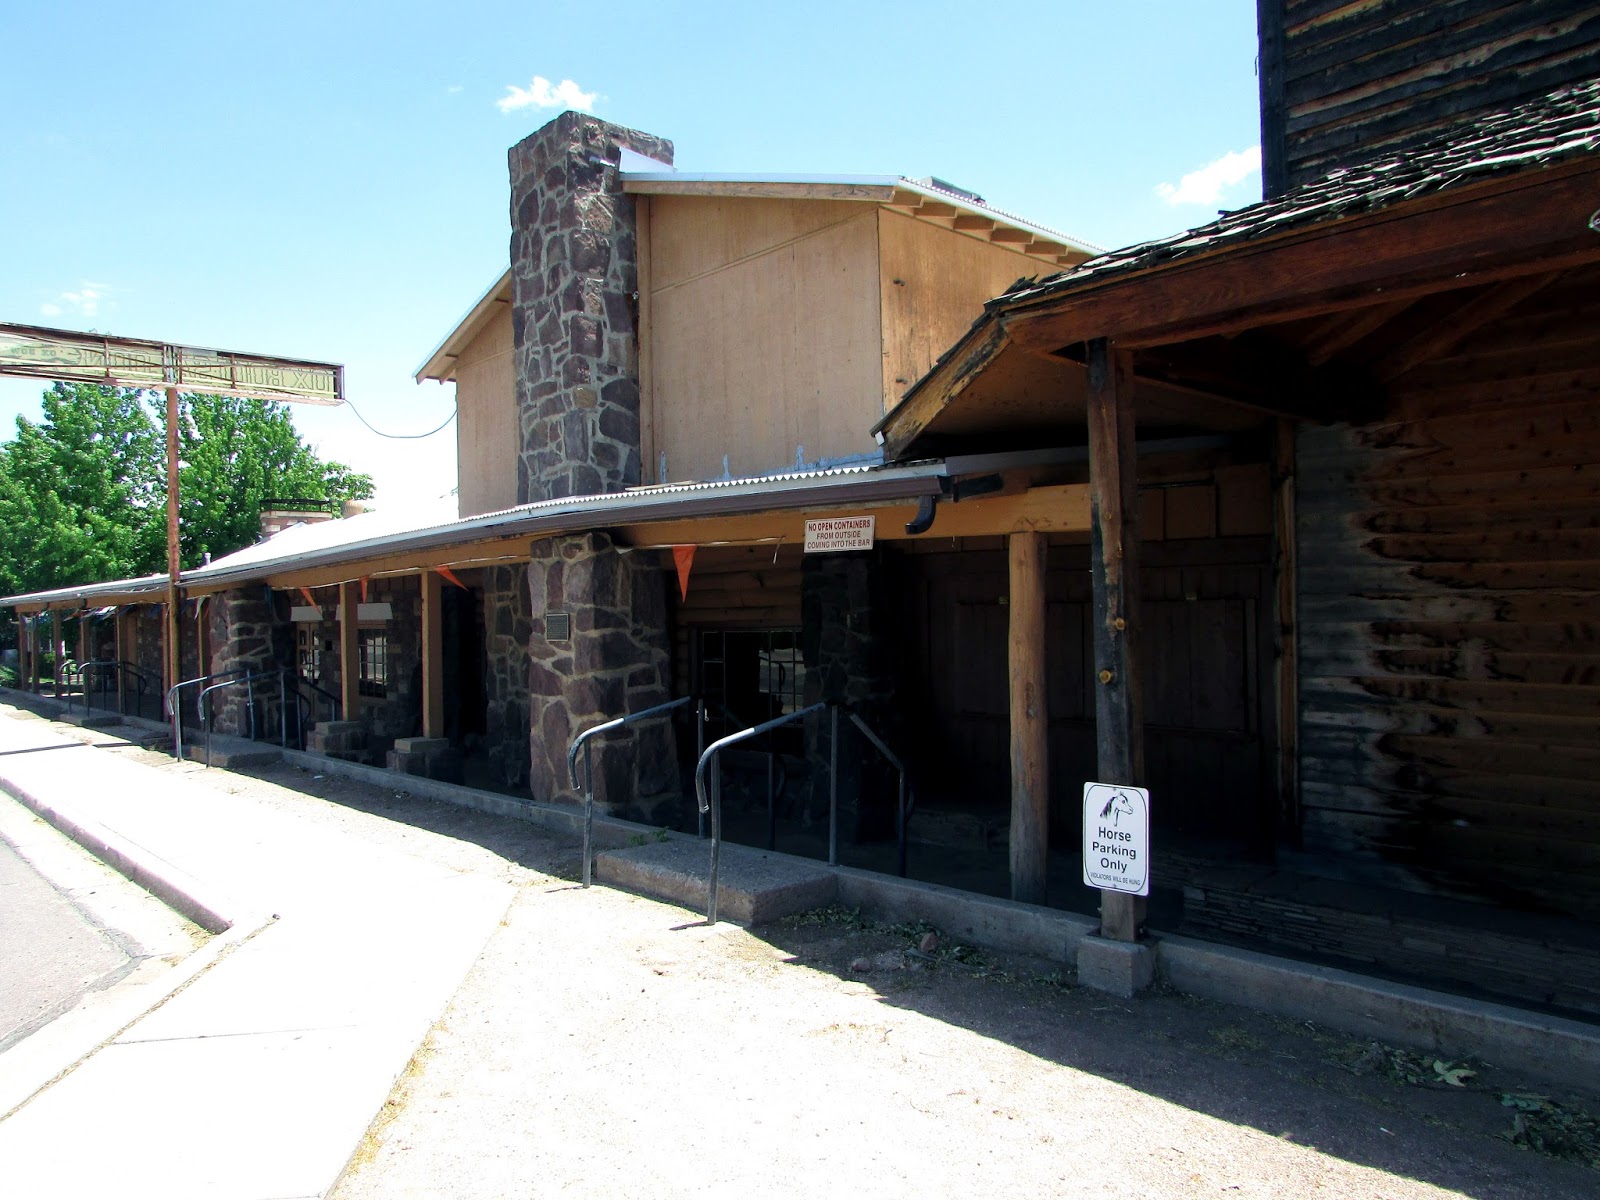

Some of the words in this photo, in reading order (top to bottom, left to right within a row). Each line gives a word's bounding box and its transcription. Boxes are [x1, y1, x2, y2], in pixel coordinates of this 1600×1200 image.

[808, 523, 817, 531] NO
[818, 522, 833, 531] OPEN
[834, 520, 871, 530] CONTAINERS
[817, 532, 833, 540] FROM
[835, 531, 861, 539] OUTSIDE
[807, 541, 830, 549] COMING
[831, 540, 844, 548] INTO
[845, 539, 856, 547] THE
[858, 539, 870, 547] BAR
[1098, 826, 1132, 842] Horse
[1092, 841, 1137, 860] Parking
[1100, 857, 1128, 874] Only
[1090, 872, 1111, 881] VIOLATORS
[1112, 875, 1122, 883] WILL
